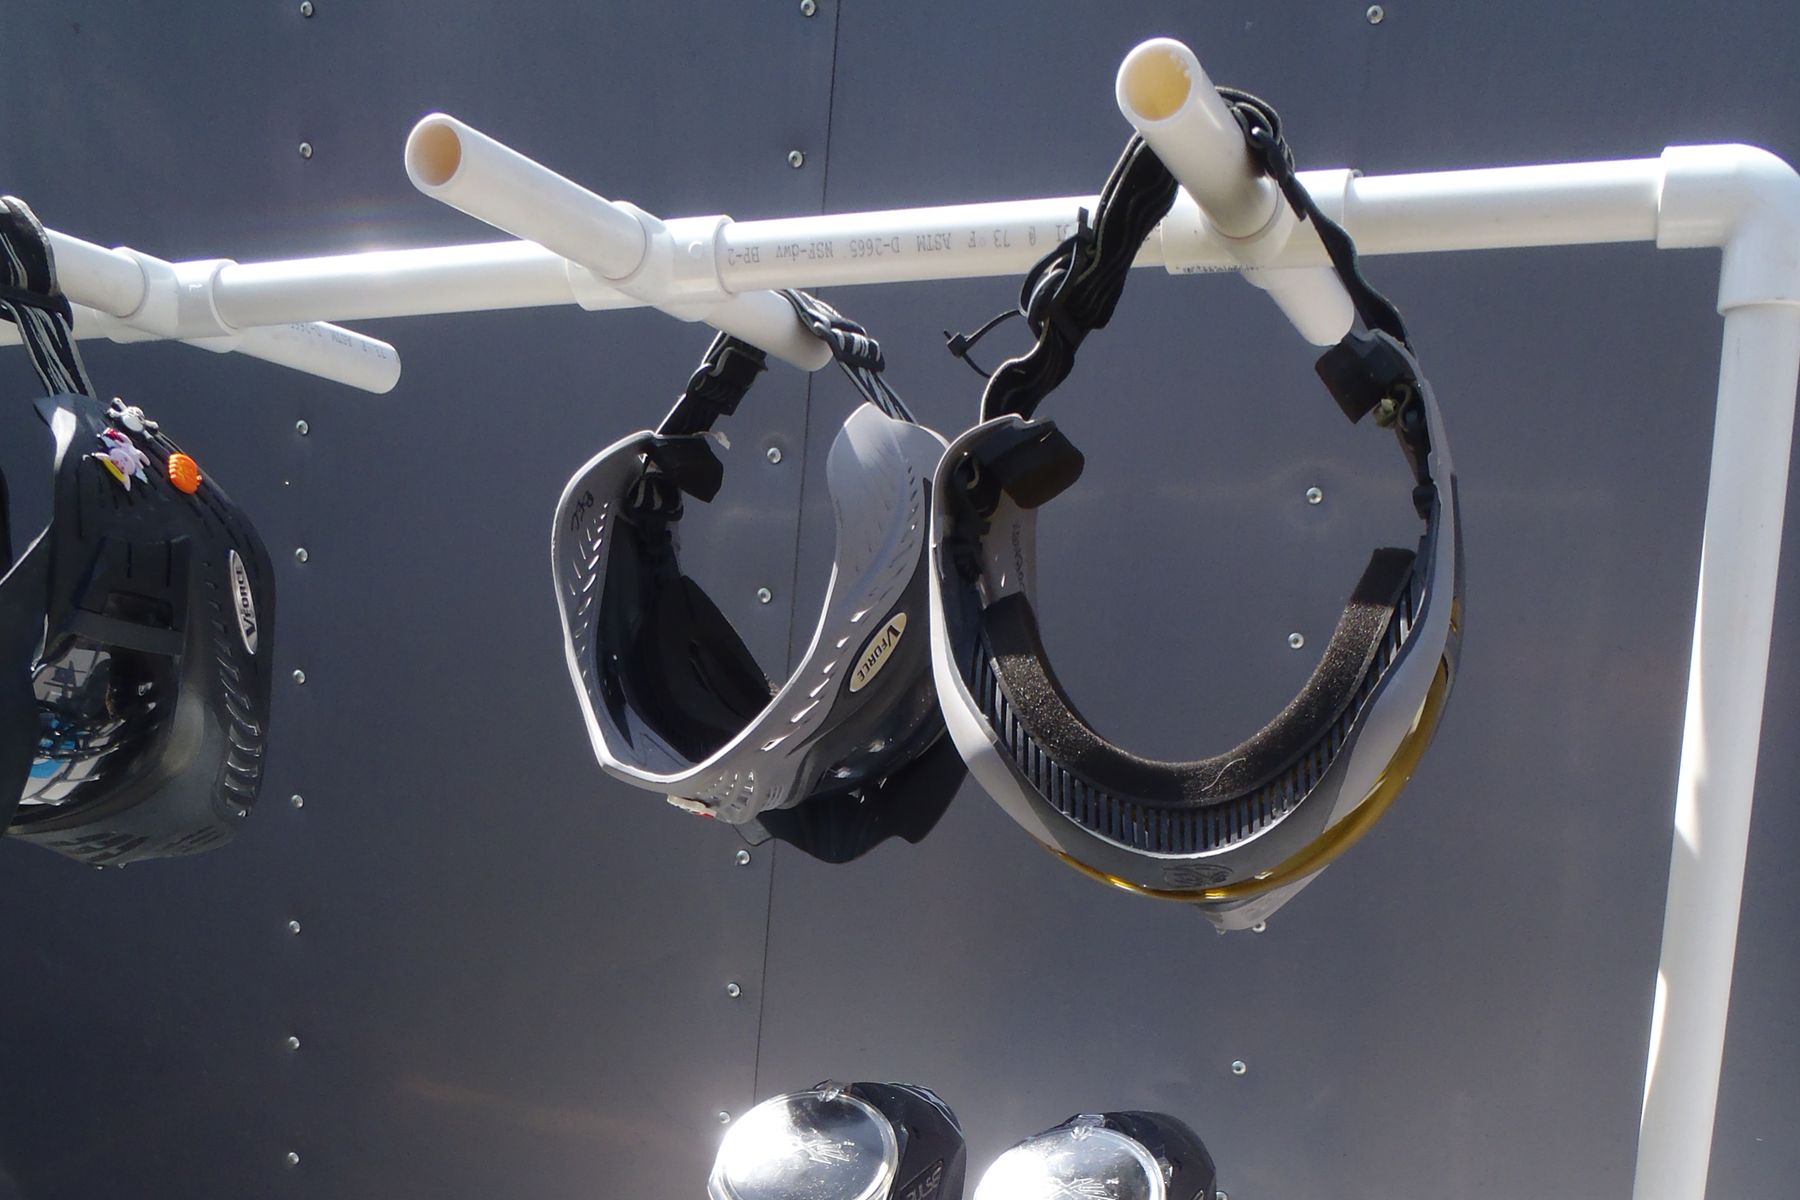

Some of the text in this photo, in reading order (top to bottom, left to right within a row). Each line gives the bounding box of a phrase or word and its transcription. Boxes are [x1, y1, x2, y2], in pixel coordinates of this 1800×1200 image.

[849, 236, 900, 259] D-2665
[916, 232, 951, 254] ASTM
[993, 228, 1011, 249] 73
